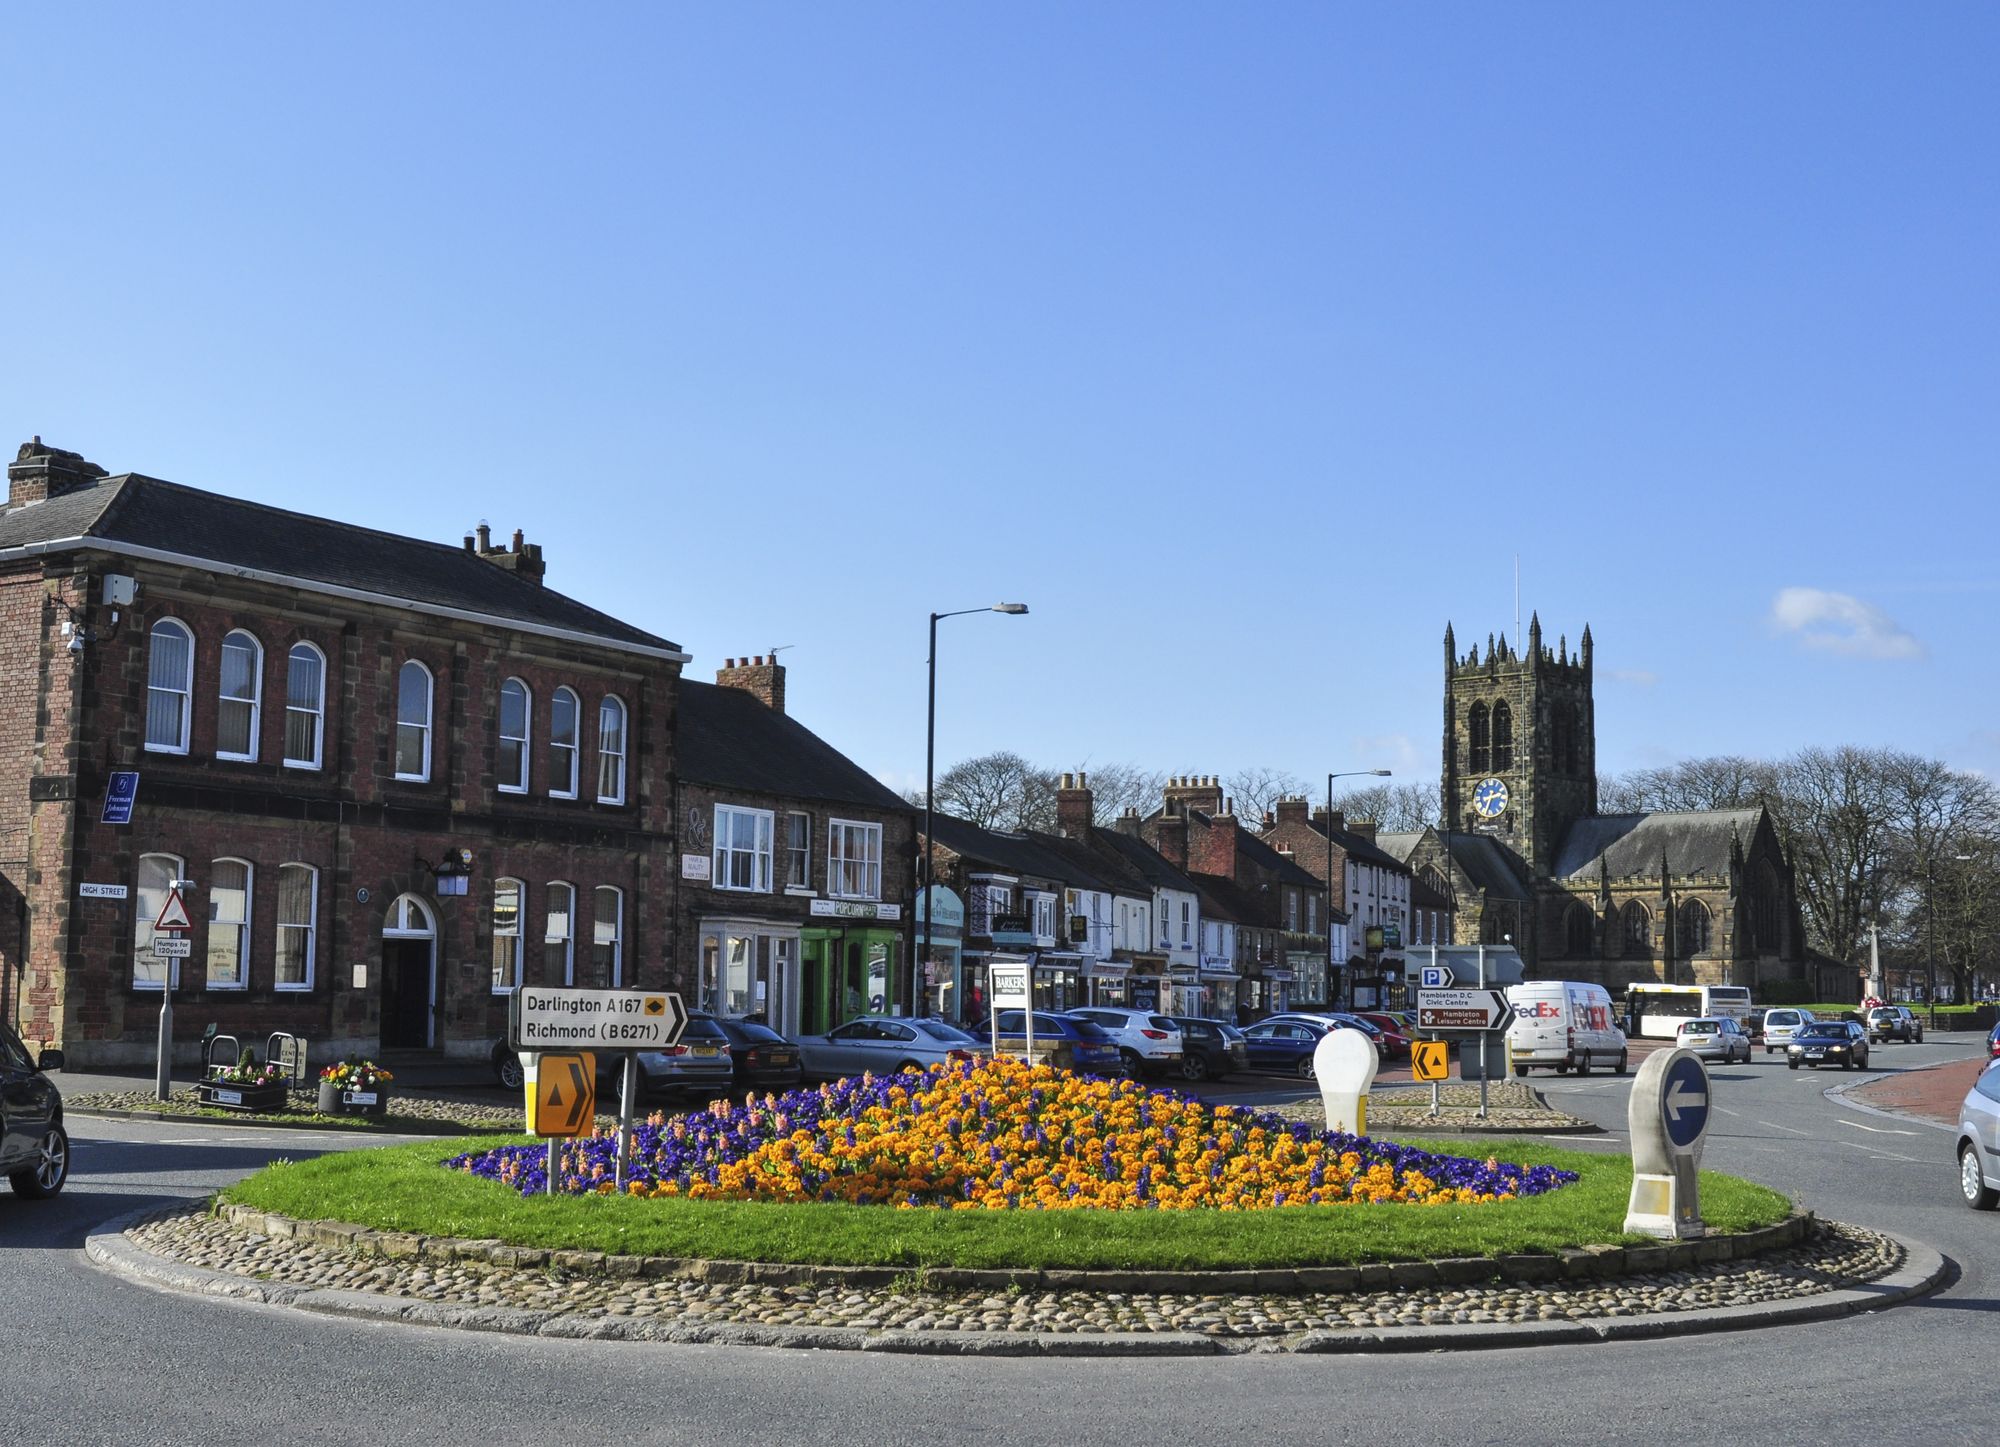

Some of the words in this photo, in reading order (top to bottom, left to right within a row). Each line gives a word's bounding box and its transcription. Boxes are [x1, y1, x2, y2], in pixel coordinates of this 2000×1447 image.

[82, 886, 98, 894] HIGH
[100, 887, 126, 895] STREET
[835, 901, 865, 917] POPCORN
[156, 940, 178, 948] Humps
[995, 976, 1026, 989] BARKERS
[1427, 971, 1438, 984] P
[527, 996, 601, 1015] Darlington
[1511, 1002, 1560, 1018] FedEx
[526, 1022, 596, 1038] Richmond
